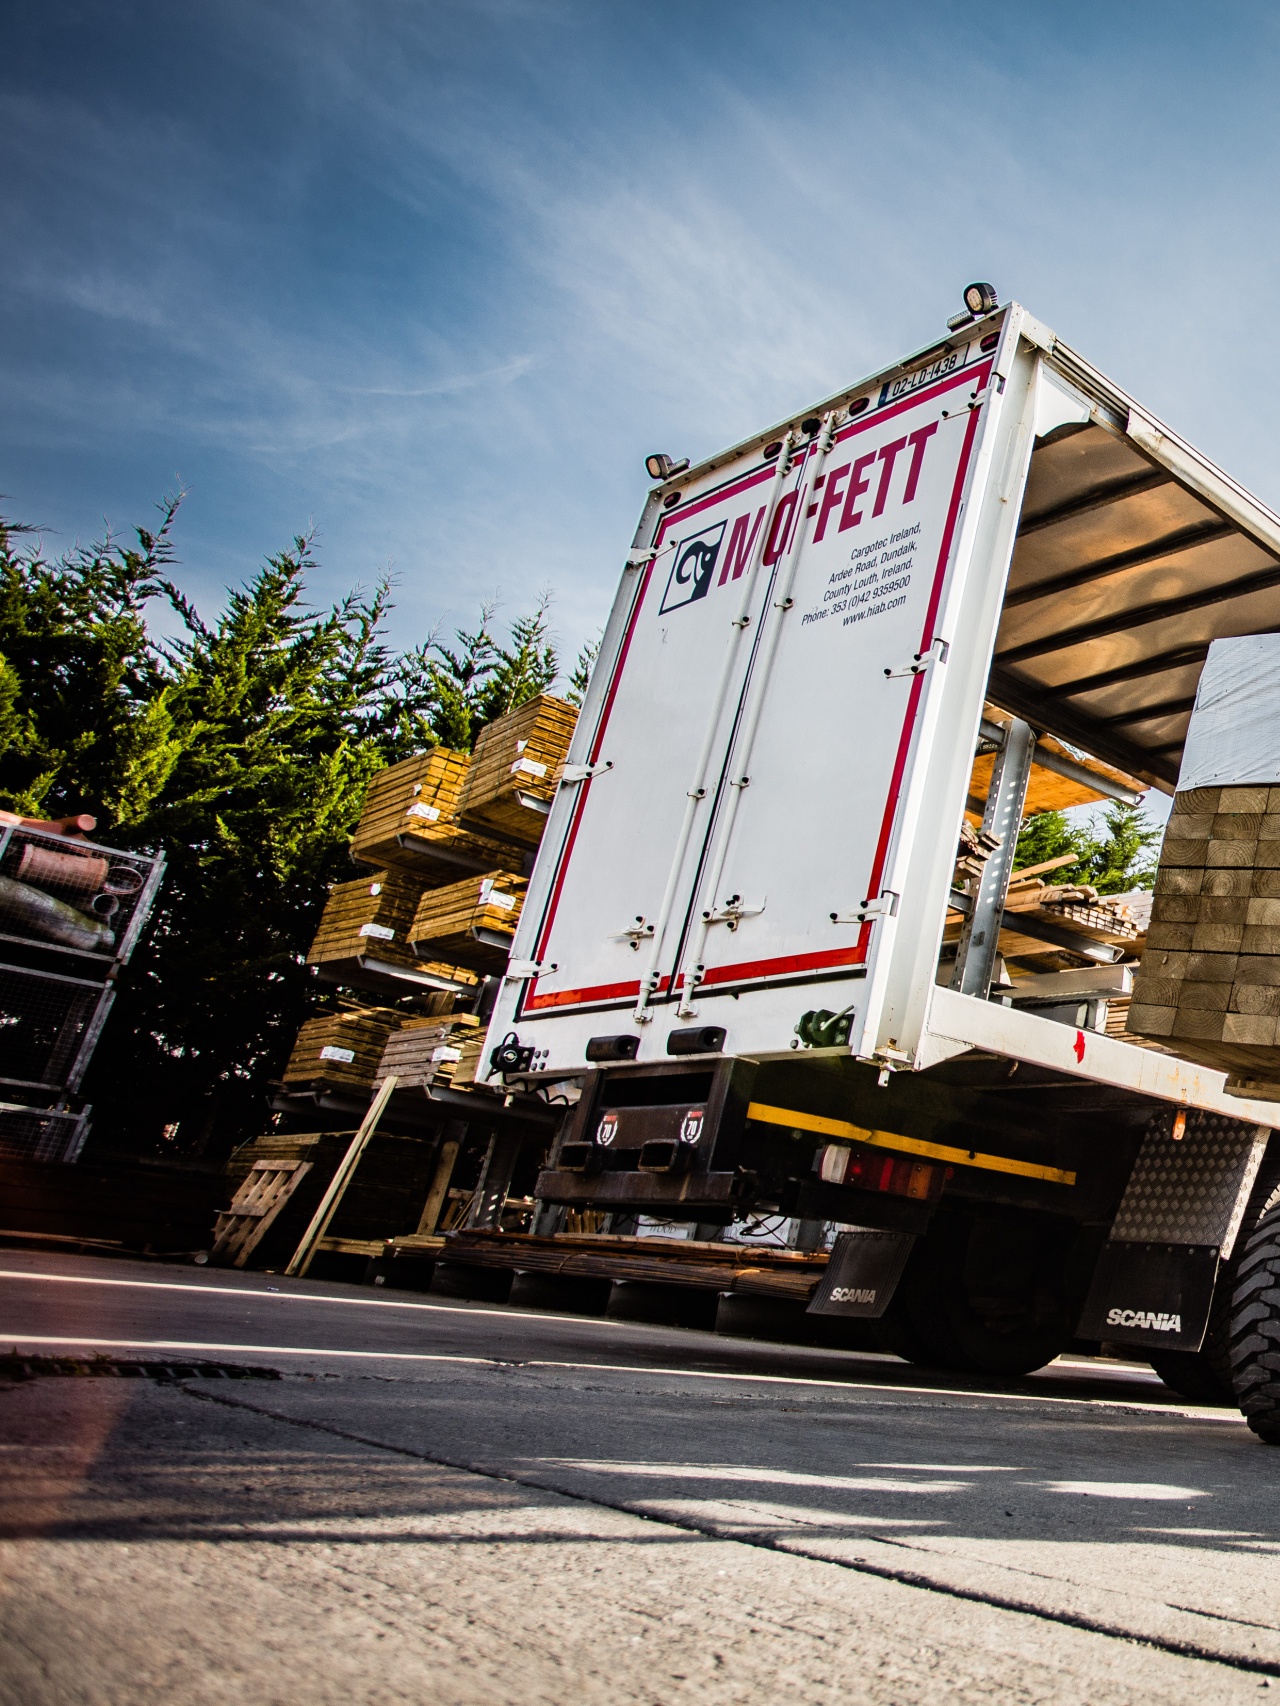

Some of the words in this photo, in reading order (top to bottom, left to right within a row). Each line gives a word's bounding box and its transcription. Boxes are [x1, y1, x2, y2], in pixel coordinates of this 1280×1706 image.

[892, 354, 957, 397] 02-LD-1438
[851, 538, 888, 560] Cargotec
[889, 521, 921, 544] Ireland,
[823, 583, 852, 602] County
[853, 572, 879, 591] Louth,
[881, 557, 913, 579] Ireland.
[828, 568, 853, 585] Ardee
[855, 556, 878, 575] Road,
[880, 540, 917, 564] Dundalk,
[801, 608, 829, 626] Phone:
[831, 600, 848, 615] 353
[848, 590, 871, 611] (0)42
[872, 574, 911, 599] 9359500
[842, 595, 906, 626] www.hiab.com
[830, 1287, 876, 1303] SCANIA
[1106, 1308, 1181, 1332] SCANIA
